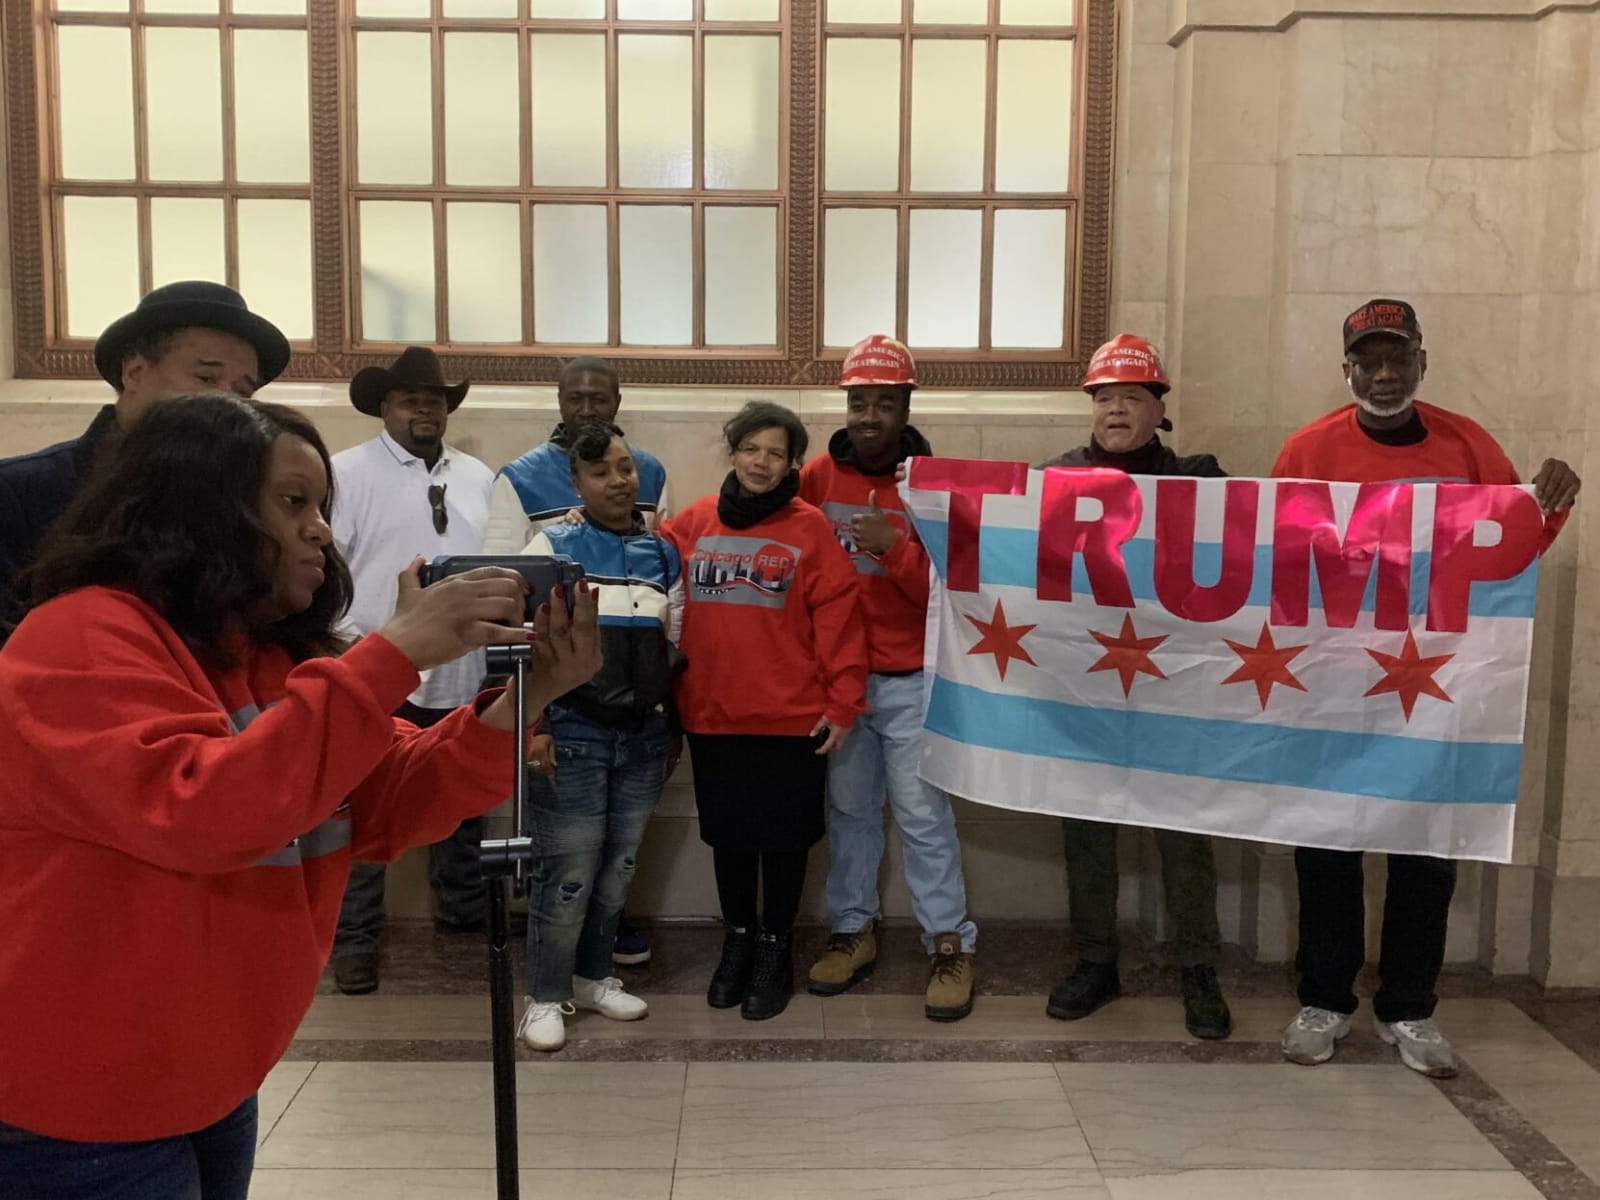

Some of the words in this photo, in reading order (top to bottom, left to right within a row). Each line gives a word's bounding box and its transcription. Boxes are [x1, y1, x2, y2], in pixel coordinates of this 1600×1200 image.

[867, 346, 905, 364] AMERICA
[1113, 347, 1155, 364] AMERICA
[908, 456, 1545, 633] TRUMP
[695, 549, 752, 564] Chicago
[758, 555, 790, 568] RED
